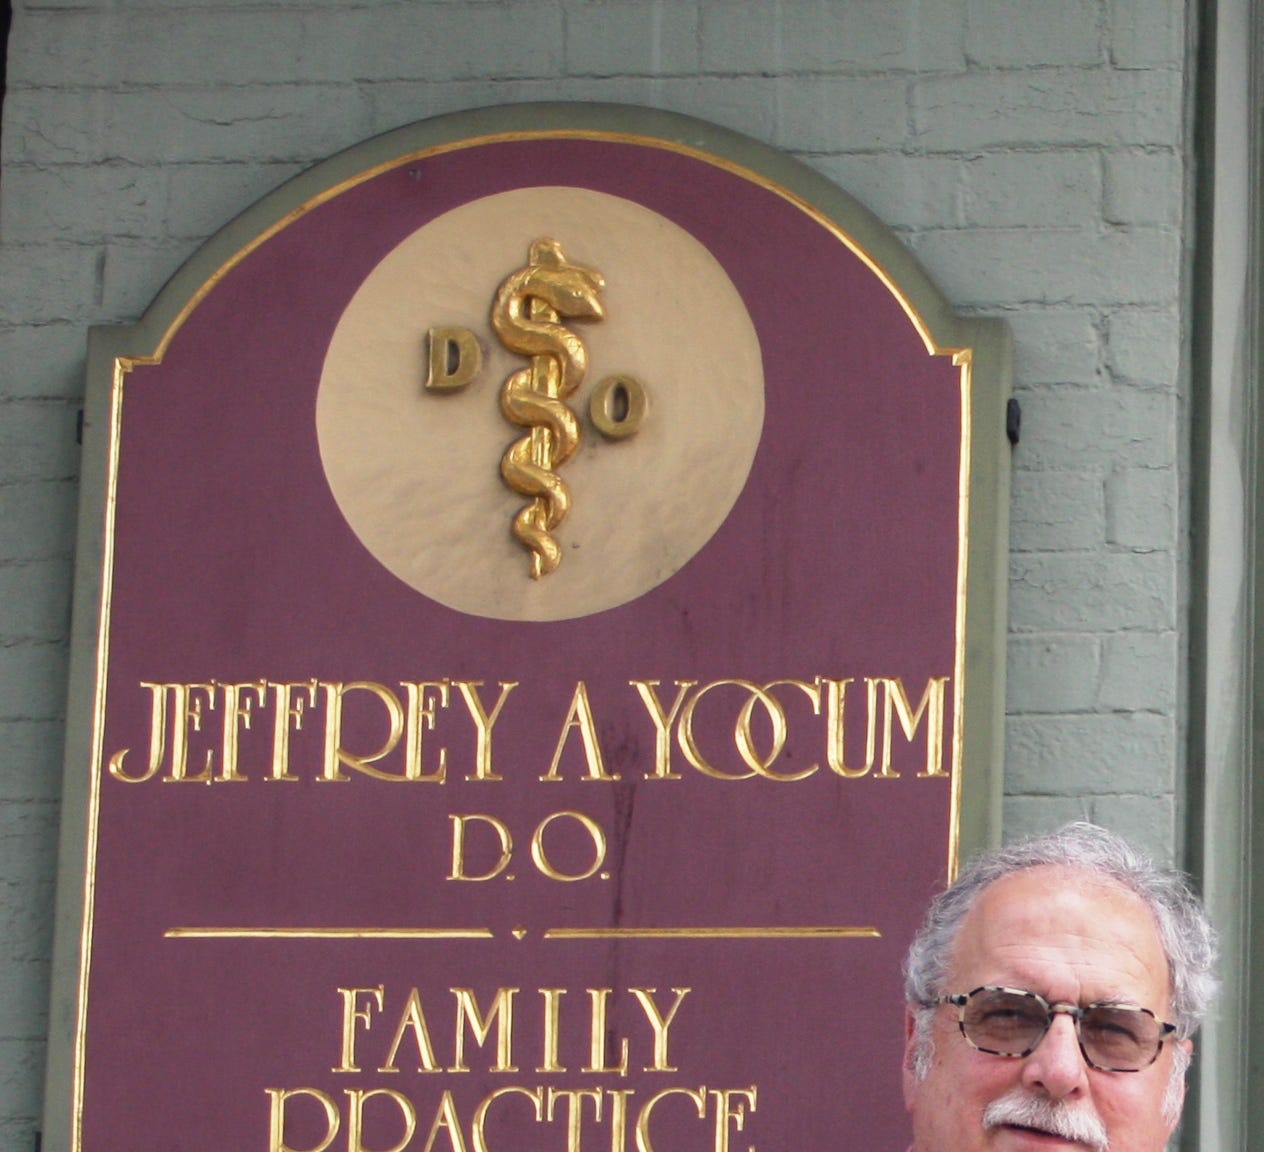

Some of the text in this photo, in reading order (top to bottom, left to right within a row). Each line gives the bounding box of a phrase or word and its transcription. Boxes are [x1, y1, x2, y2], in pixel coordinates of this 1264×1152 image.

[423, 327, 650, 440] D O
[108, 675, 952, 784] JEFFREY A. YOCUM
[446, 811, 611, 882] D.O.
[330, 984, 692, 1073] FAMILY
